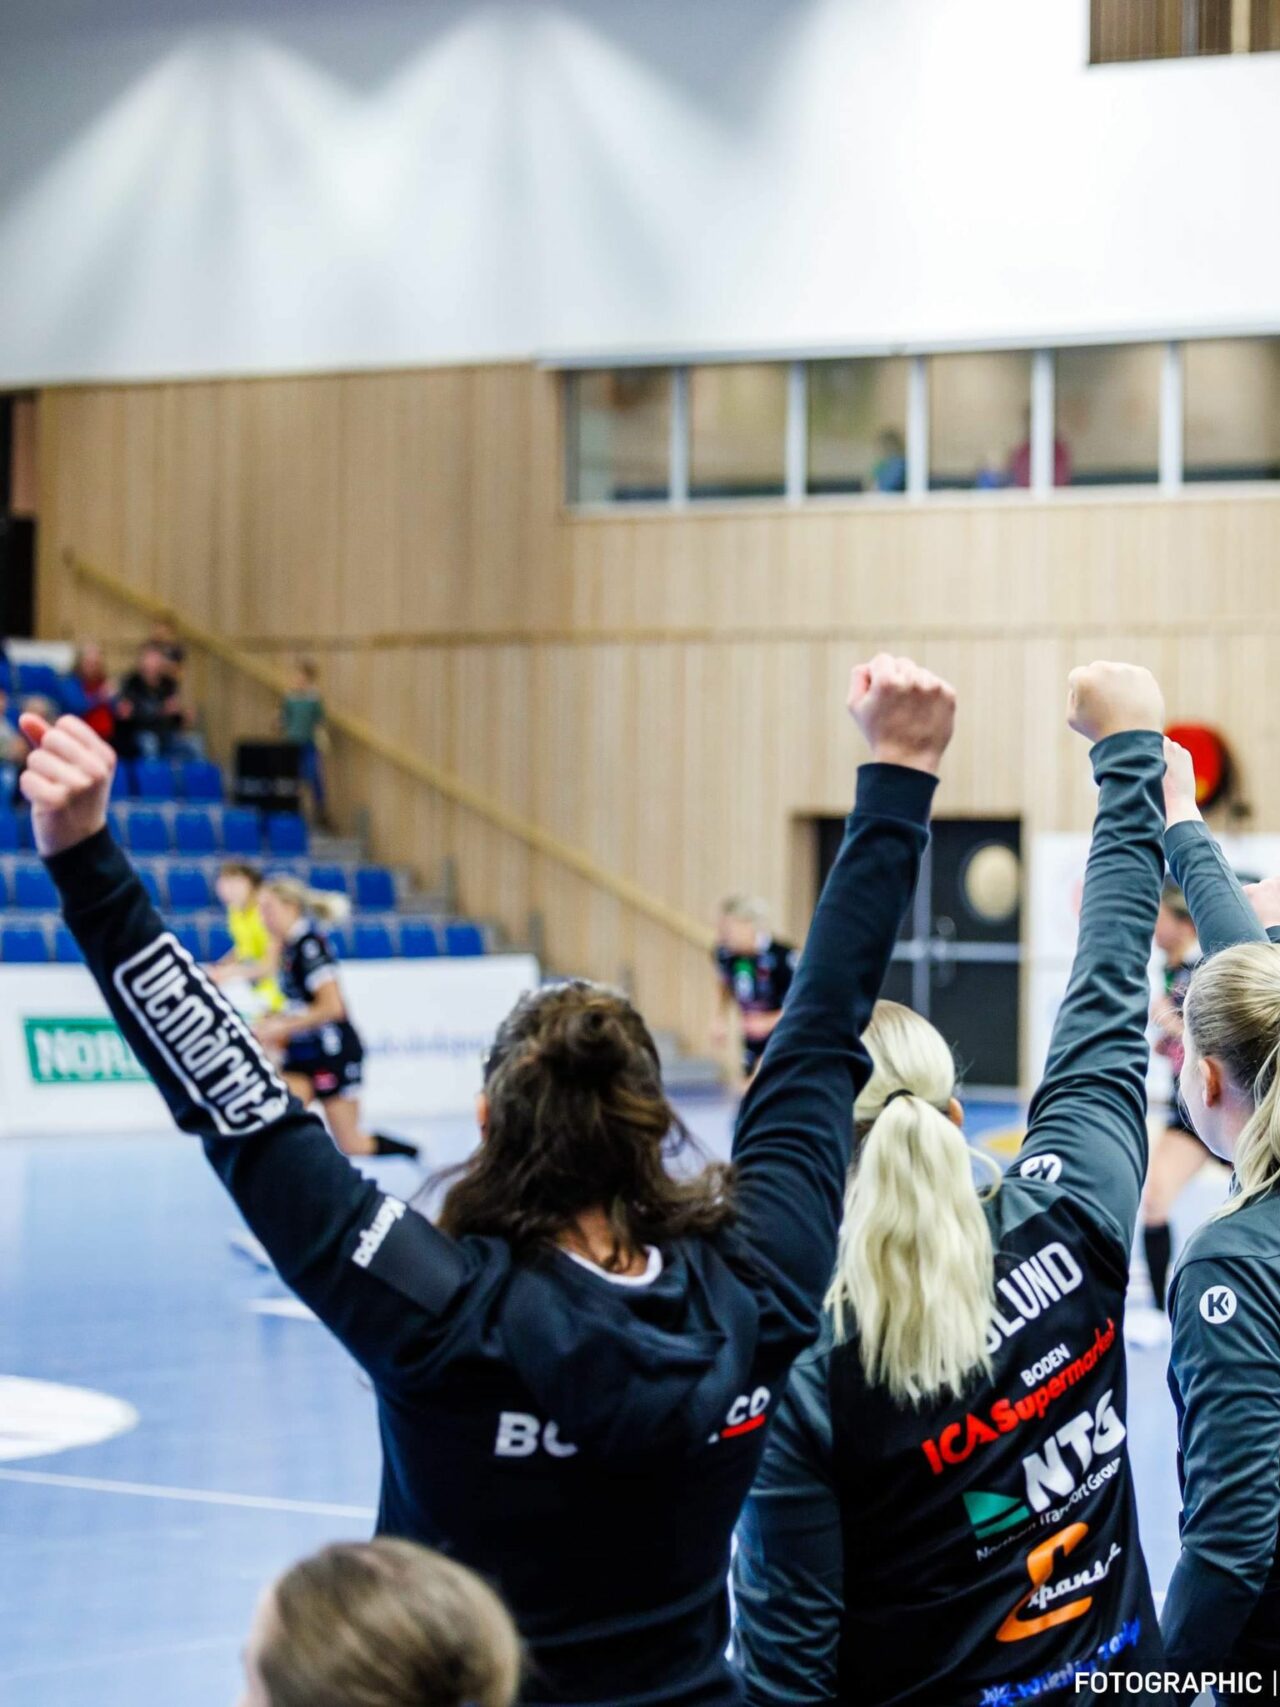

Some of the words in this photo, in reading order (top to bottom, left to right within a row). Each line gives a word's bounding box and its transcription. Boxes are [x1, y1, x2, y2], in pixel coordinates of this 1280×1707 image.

[34, 1027, 150, 1079] NOR
[1020, 1343, 1071, 1388] BODEN
[921, 1412, 1000, 1476] ICA
[1022, 1388, 1127, 1513] NTG
